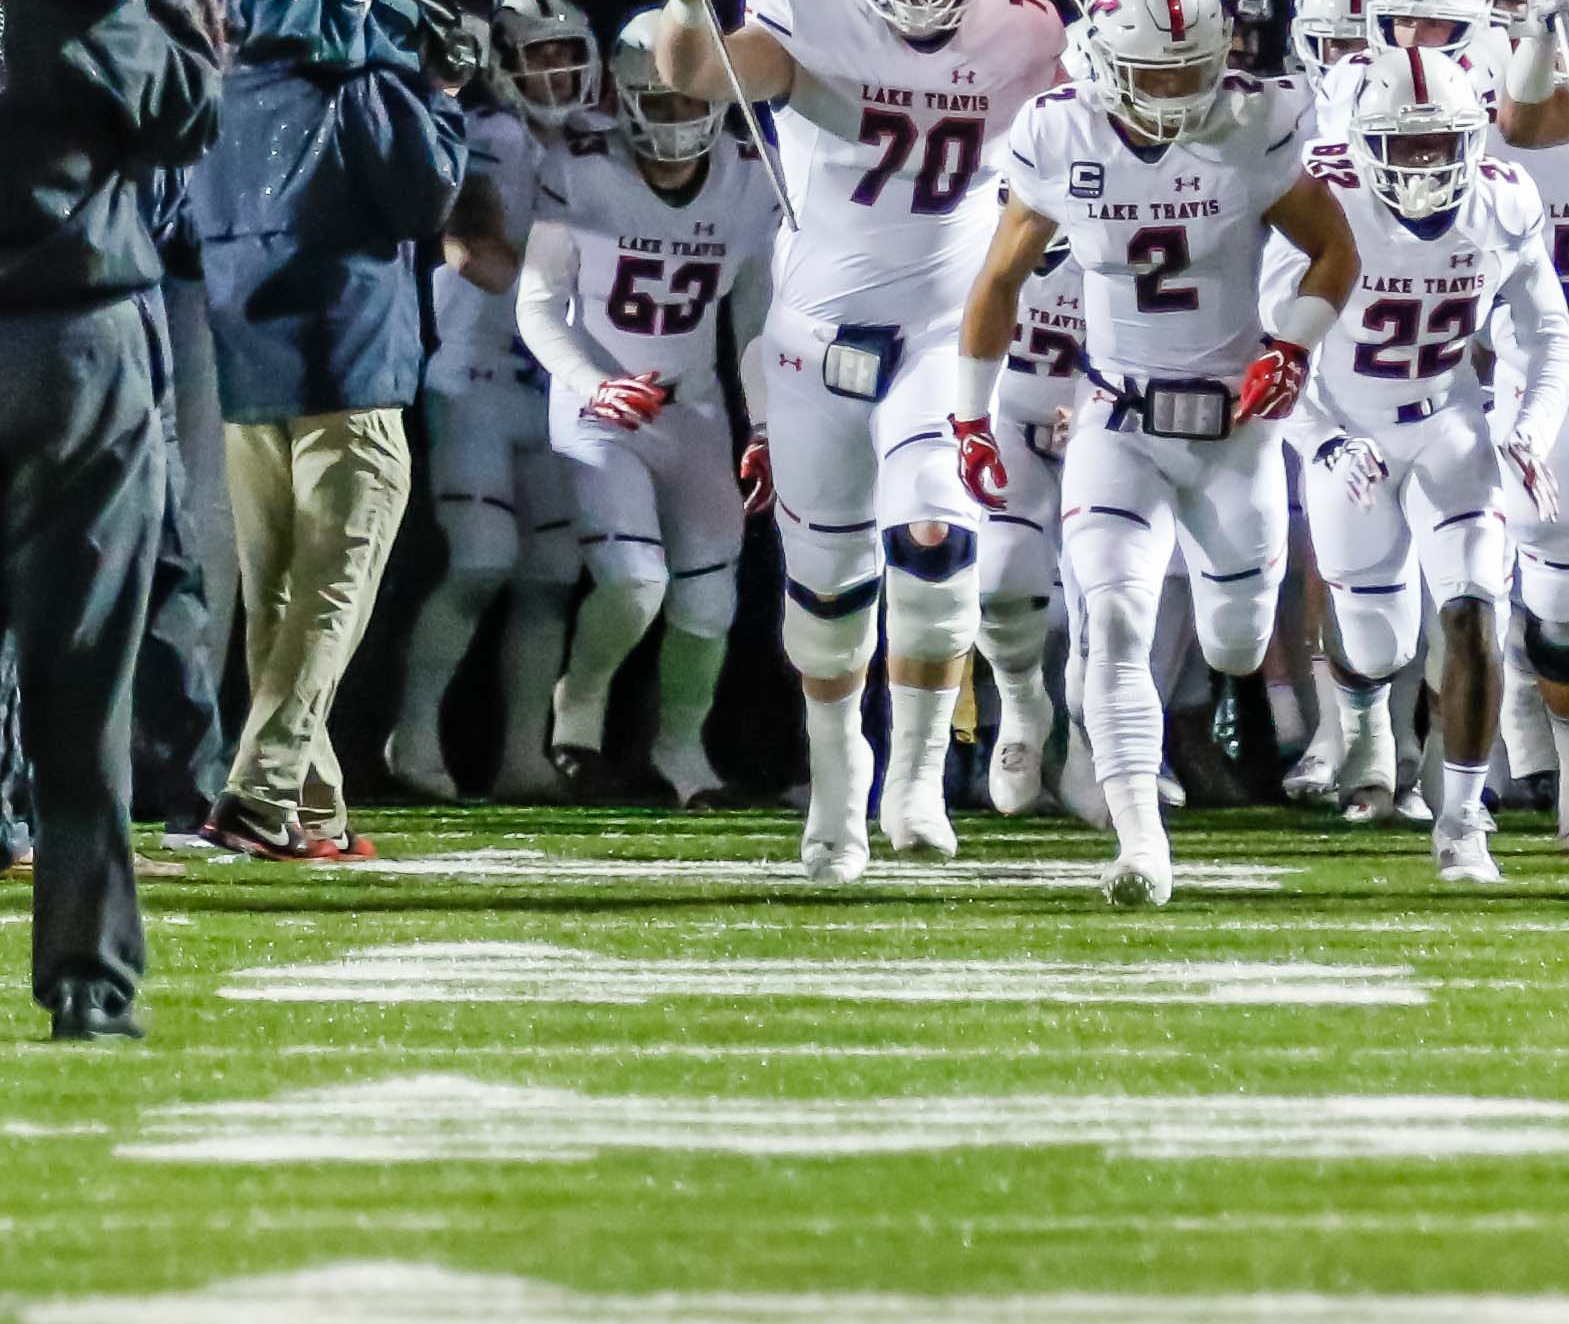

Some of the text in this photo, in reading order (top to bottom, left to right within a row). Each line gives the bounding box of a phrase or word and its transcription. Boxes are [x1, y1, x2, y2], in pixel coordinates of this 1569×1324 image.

[862, 84, 989, 111] LAKE TRAVIS
[850, 107, 986, 214] 70
[1088, 200, 1221, 220] LAKE TRAVIS
[619, 236, 727, 257] LAKE TRAVIS
[1127, 225, 1199, 313] 2
[1362, 274, 1485, 294] LAKE TRAVIS
[1028, 307, 1087, 331] TRAVIS
[1353, 296, 1481, 379] 22
